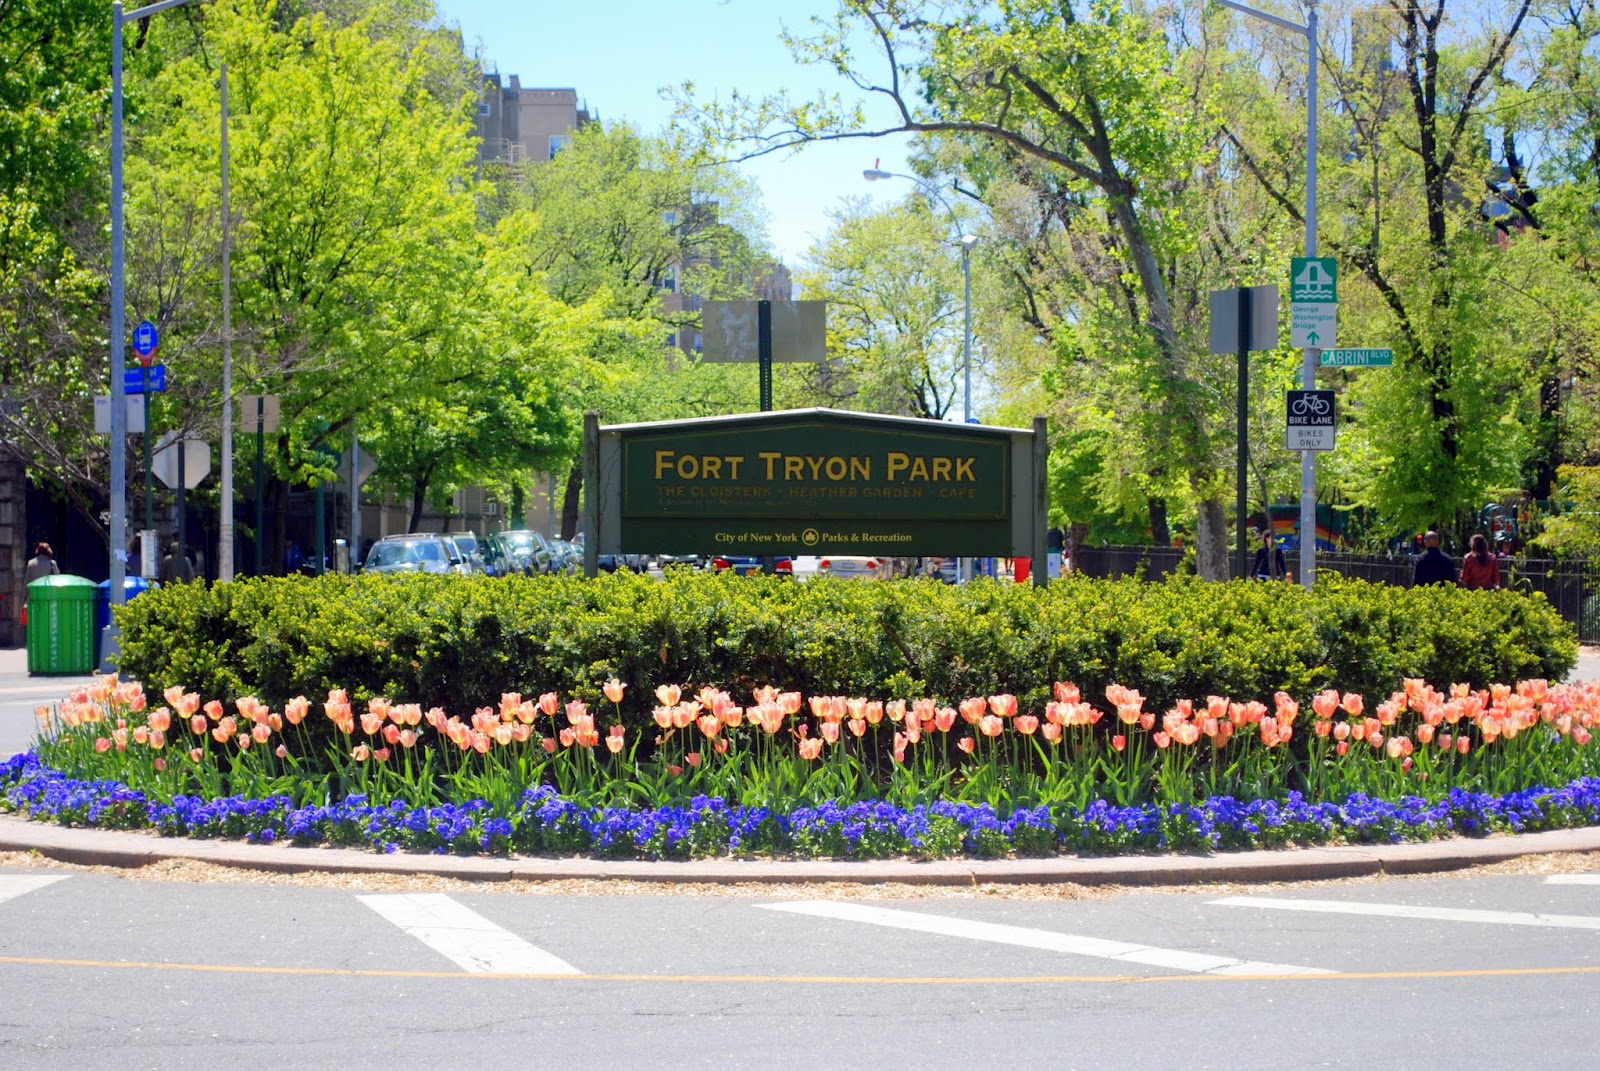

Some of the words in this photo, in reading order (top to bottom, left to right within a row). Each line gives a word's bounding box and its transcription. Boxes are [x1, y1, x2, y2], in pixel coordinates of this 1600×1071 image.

[1292, 305, 1319, 313] George
[1293, 314, 1334, 322] Washington
[1320, 350, 1369, 365] CABRINI
[1370, 351, 1390, 359] BLVD
[1289, 416, 1308, 424] BIKE
[1311, 416, 1332, 424] LANE
[1300, 439, 1321, 447] ONLY
[654, 450, 744, 480] FORT
[758, 451, 871, 481] TRYON
[886, 451, 977, 482] PARK
[657, 486, 685, 496] THE
[690, 486, 772, 497] CLOISTERS
[788, 487, 857, 497] HEATHER
[863, 487, 922, 498] GARDEN
[714, 532, 735, 543] City
[737, 532, 749, 542] of
[750, 533, 773, 542] New
[774, 532, 798, 542] York
[822, 532, 849, 542] Parks
[851, 533, 860, 542] &
[861, 532, 912, 542] Recreation
